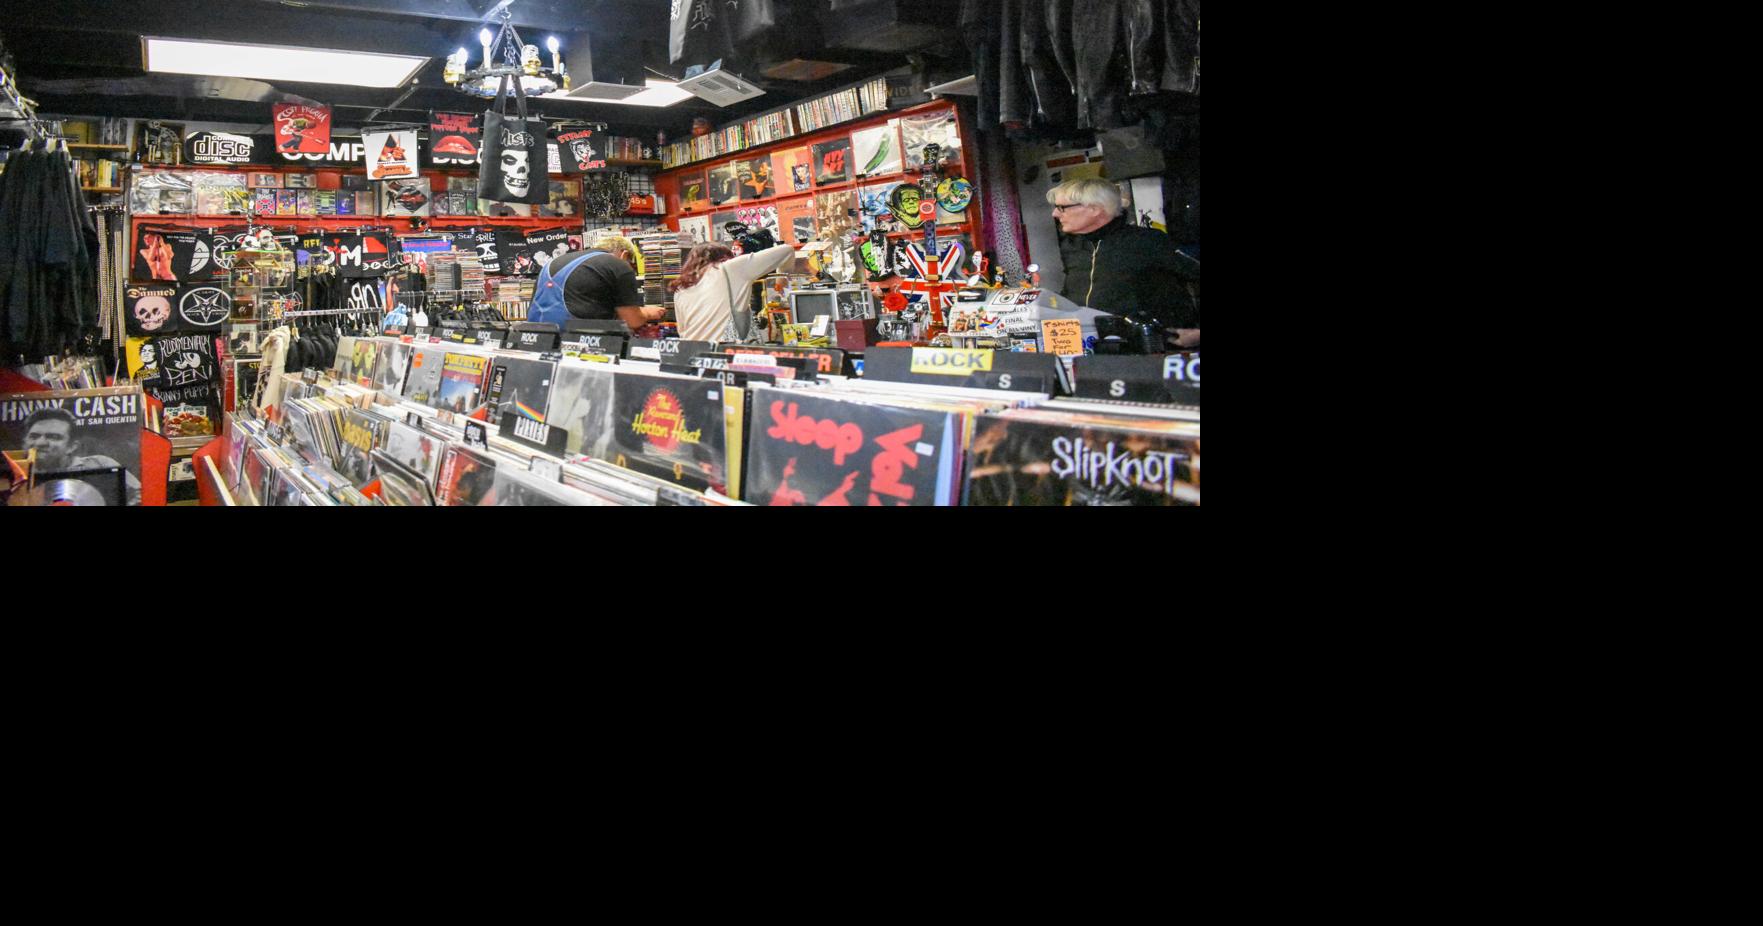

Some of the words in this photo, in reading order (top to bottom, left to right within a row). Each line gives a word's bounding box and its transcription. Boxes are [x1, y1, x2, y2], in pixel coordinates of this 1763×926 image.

[194, 134, 250, 157] disc
[526, 235, 544, 245] New
[546, 231, 567, 243] Order
[127, 288, 176, 299] Damned
[1005, 316, 1024, 324] FINAL
[521, 332, 538, 343] ROCK
[580, 335, 601, 347] ROCK
[652, 339, 680, 354] ROCK
[165, 364, 213, 386] PENI
[998, 373, 1012, 389] S
[184, 384, 210, 400] PUPPY
[1110, 379, 1125, 397] S
[75, 395, 137, 420] CASH
[88, 417, 104, 425] SAN
[105, 415, 138, 425] QUENTIN
[631, 412, 669, 438] Horton
[767, 400, 864, 466] Sleep
